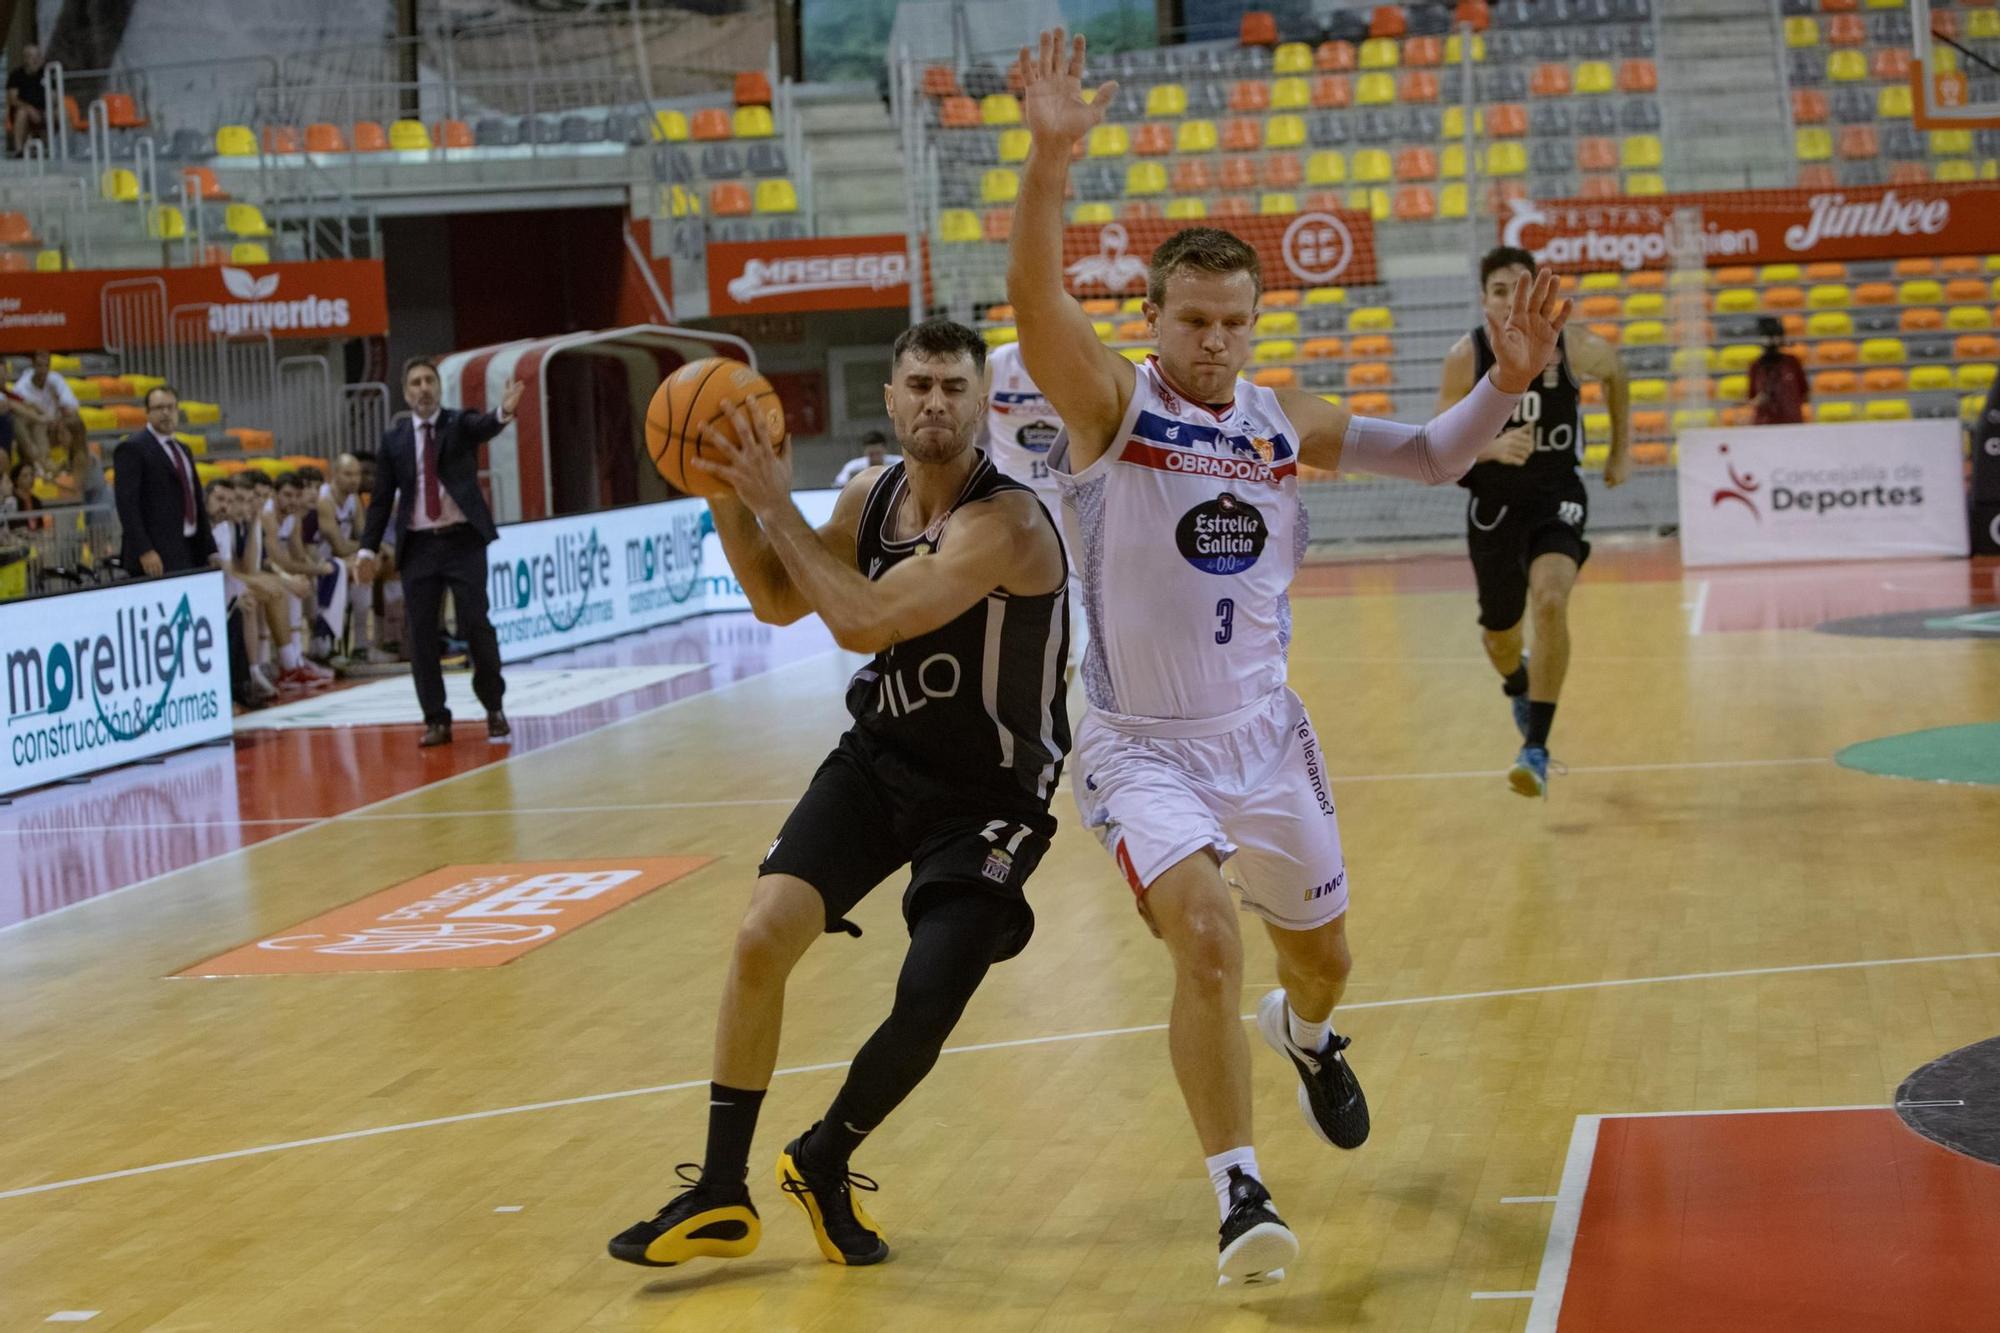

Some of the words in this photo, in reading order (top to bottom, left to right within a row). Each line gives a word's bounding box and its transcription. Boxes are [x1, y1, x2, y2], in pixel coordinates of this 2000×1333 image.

[1785, 190, 1949, 251] Jimbee
[750, 252, 906, 283] MASEGO
[208, 294, 350, 335] agriverdes
[1165, 452, 1277, 482] OBRADOIR
[1772, 485, 1923, 514] Deportes
[1194, 513, 1258, 533] Estrella
[1196, 534, 1253, 554] Galicia
[491, 532, 611, 609] morellière
[1215, 598, 1235, 645] 3
[6, 602, 214, 715] morellière
[1302, 739, 1335, 817] llevamos?
[444, 869, 643, 918] FEB
